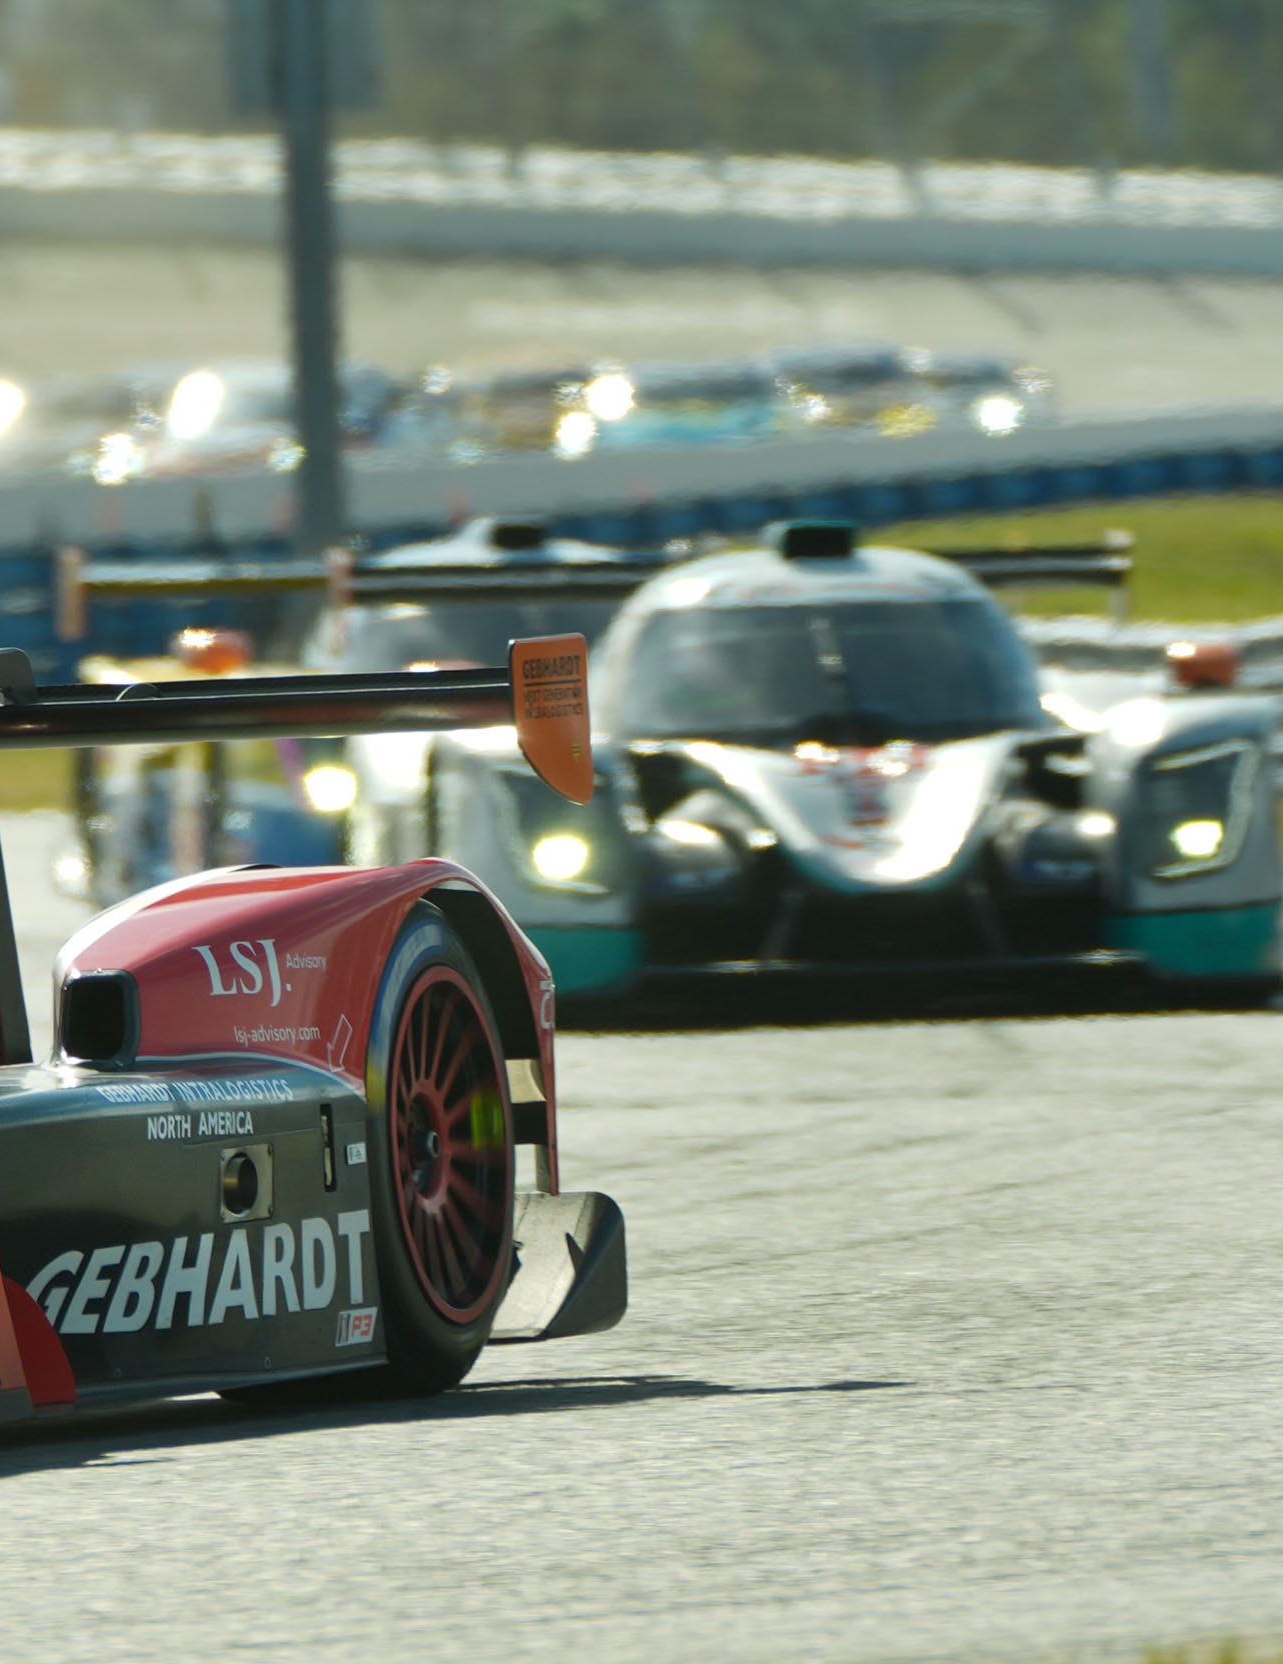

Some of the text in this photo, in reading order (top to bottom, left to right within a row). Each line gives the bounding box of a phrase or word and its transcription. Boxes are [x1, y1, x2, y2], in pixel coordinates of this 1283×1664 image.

[286, 953, 327, 971] Advisory
[234, 1025, 321, 1048] lsj-advisory.com
[96, 1079, 294, 1103] GEBHARDT INTRALOGISTICS
[147, 1111, 254, 1140] NORTH AMERICA
[26, 1209, 370, 1334] GEBHARDT
[351, 1313, 373, 1338] P3
